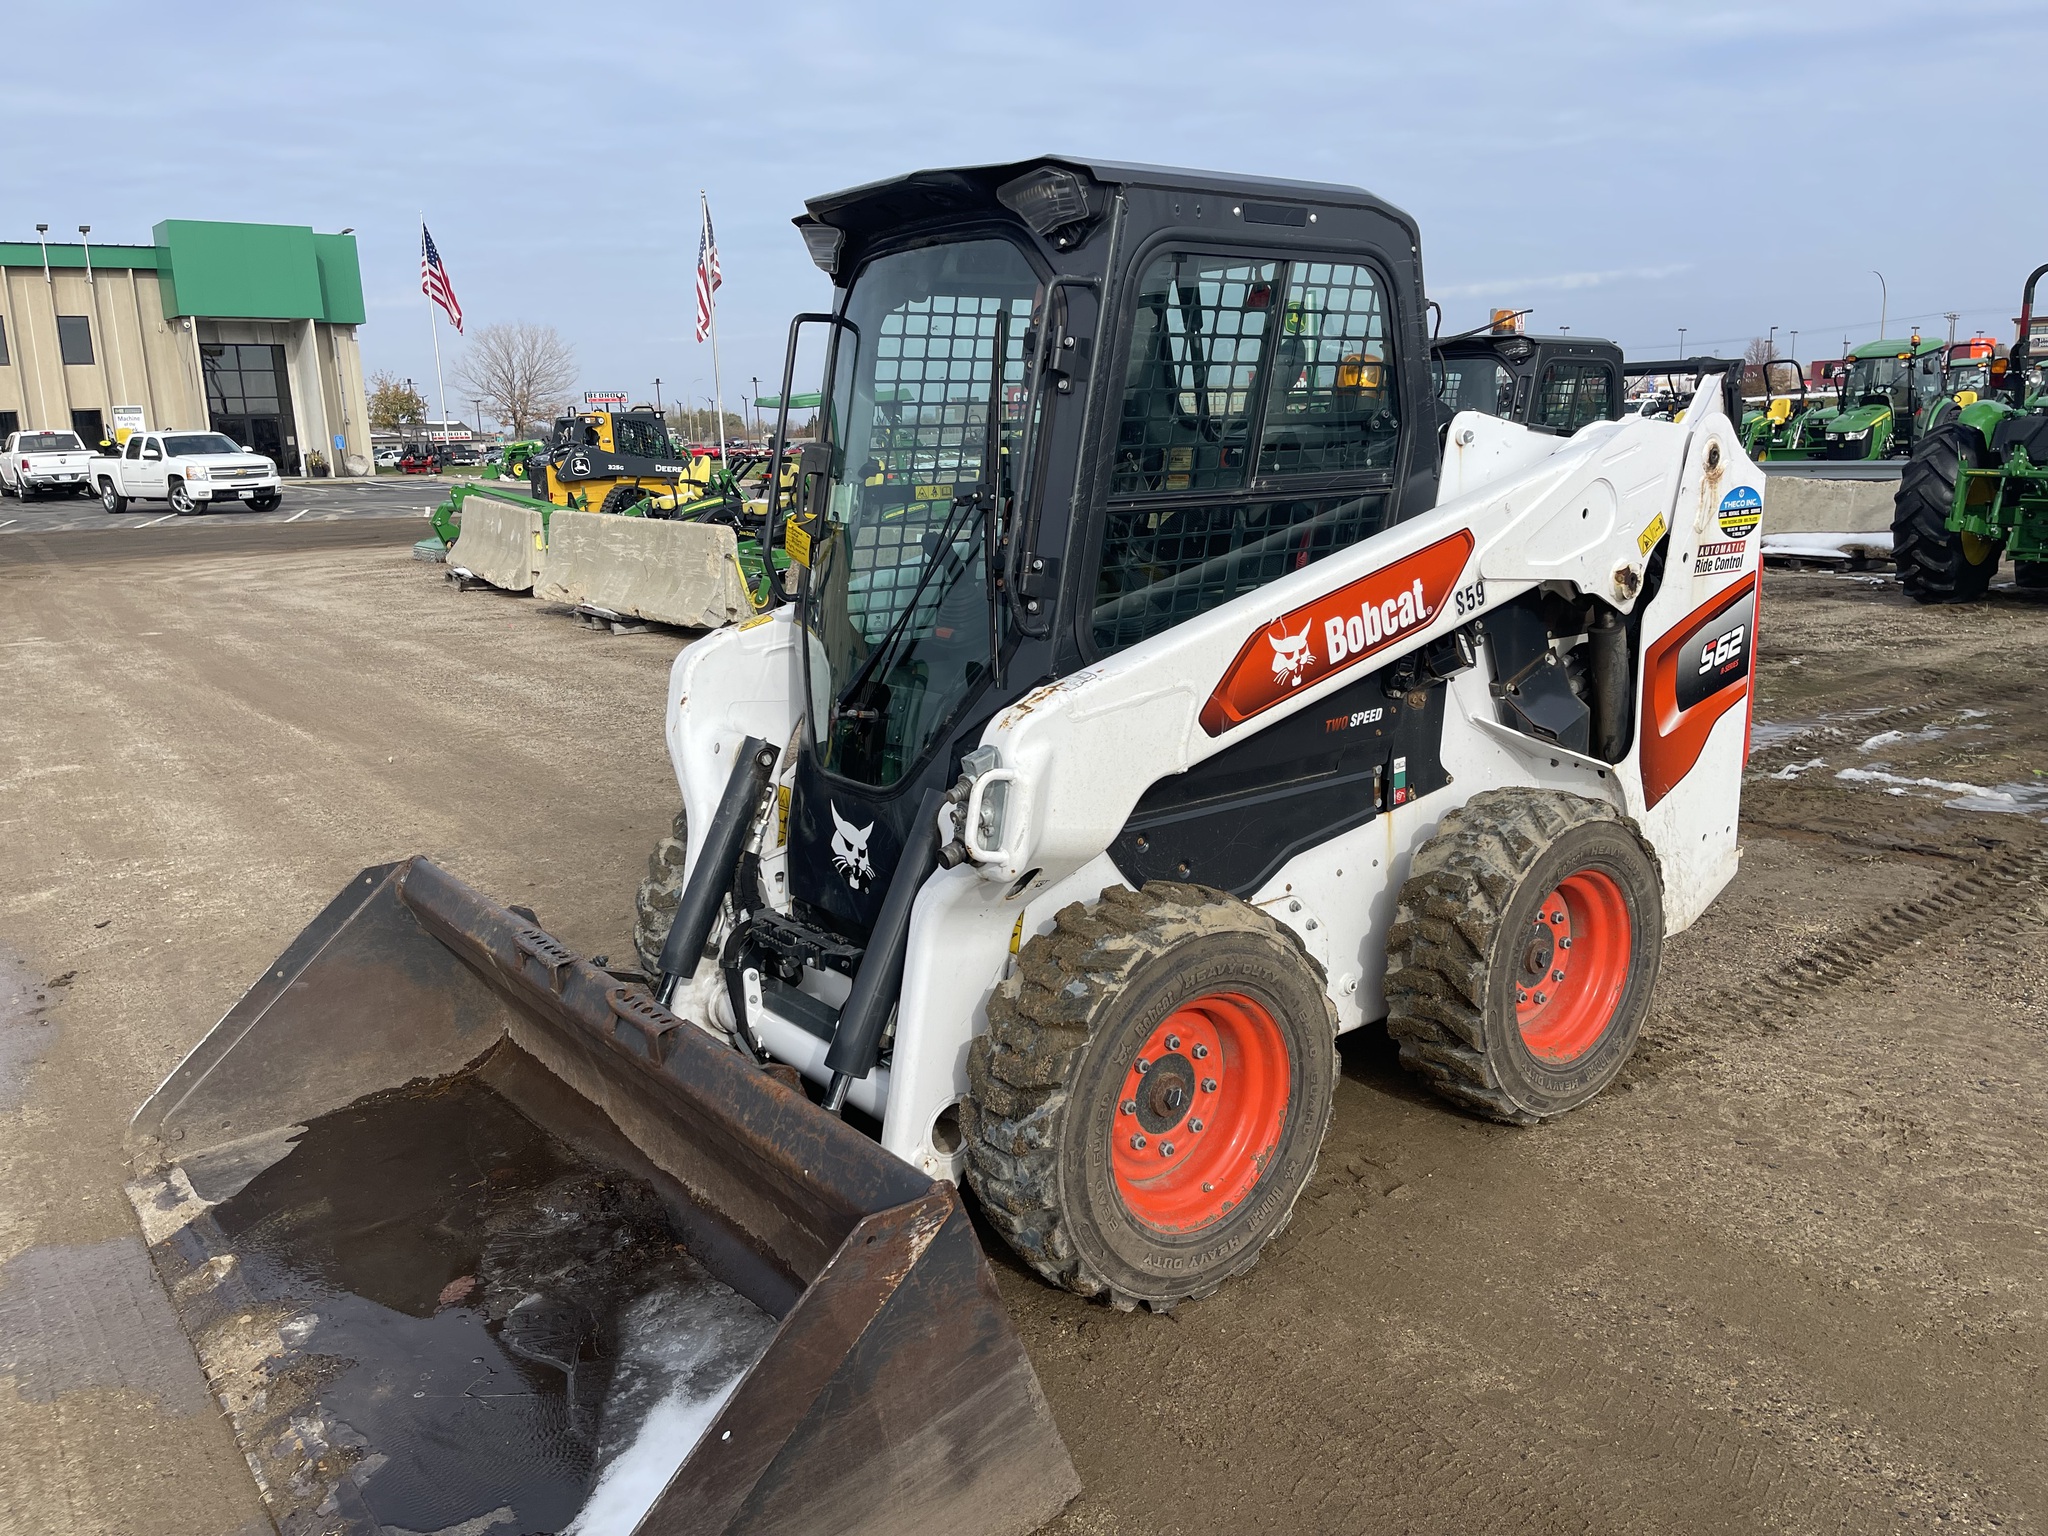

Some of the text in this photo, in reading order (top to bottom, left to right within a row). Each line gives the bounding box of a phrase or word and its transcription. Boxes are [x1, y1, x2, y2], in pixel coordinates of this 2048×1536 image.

[655, 464, 683, 473] DEERE
[1724, 499, 1746, 509] THECO
[1694, 553, 1745, 574] Ride Control
[1698, 542, 1745, 556] AUTOMATIC
[1455, 581, 1486, 616] S59
[1324, 577, 1427, 666] Bobcat
[1698, 623, 1745, 676] S62
[1325, 707, 1383, 734] TWO SPEED
[1134, 990, 1176, 1039] Bobcat
[1184, 962, 1239, 989] HEAVY
[1242, 963, 1279, 985] DUTY
[1094, 1180, 1119, 1233] BEAD
[1143, 1252, 1185, 1269] DUTY
[1188, 1234, 1241, 1268] HEAVY
